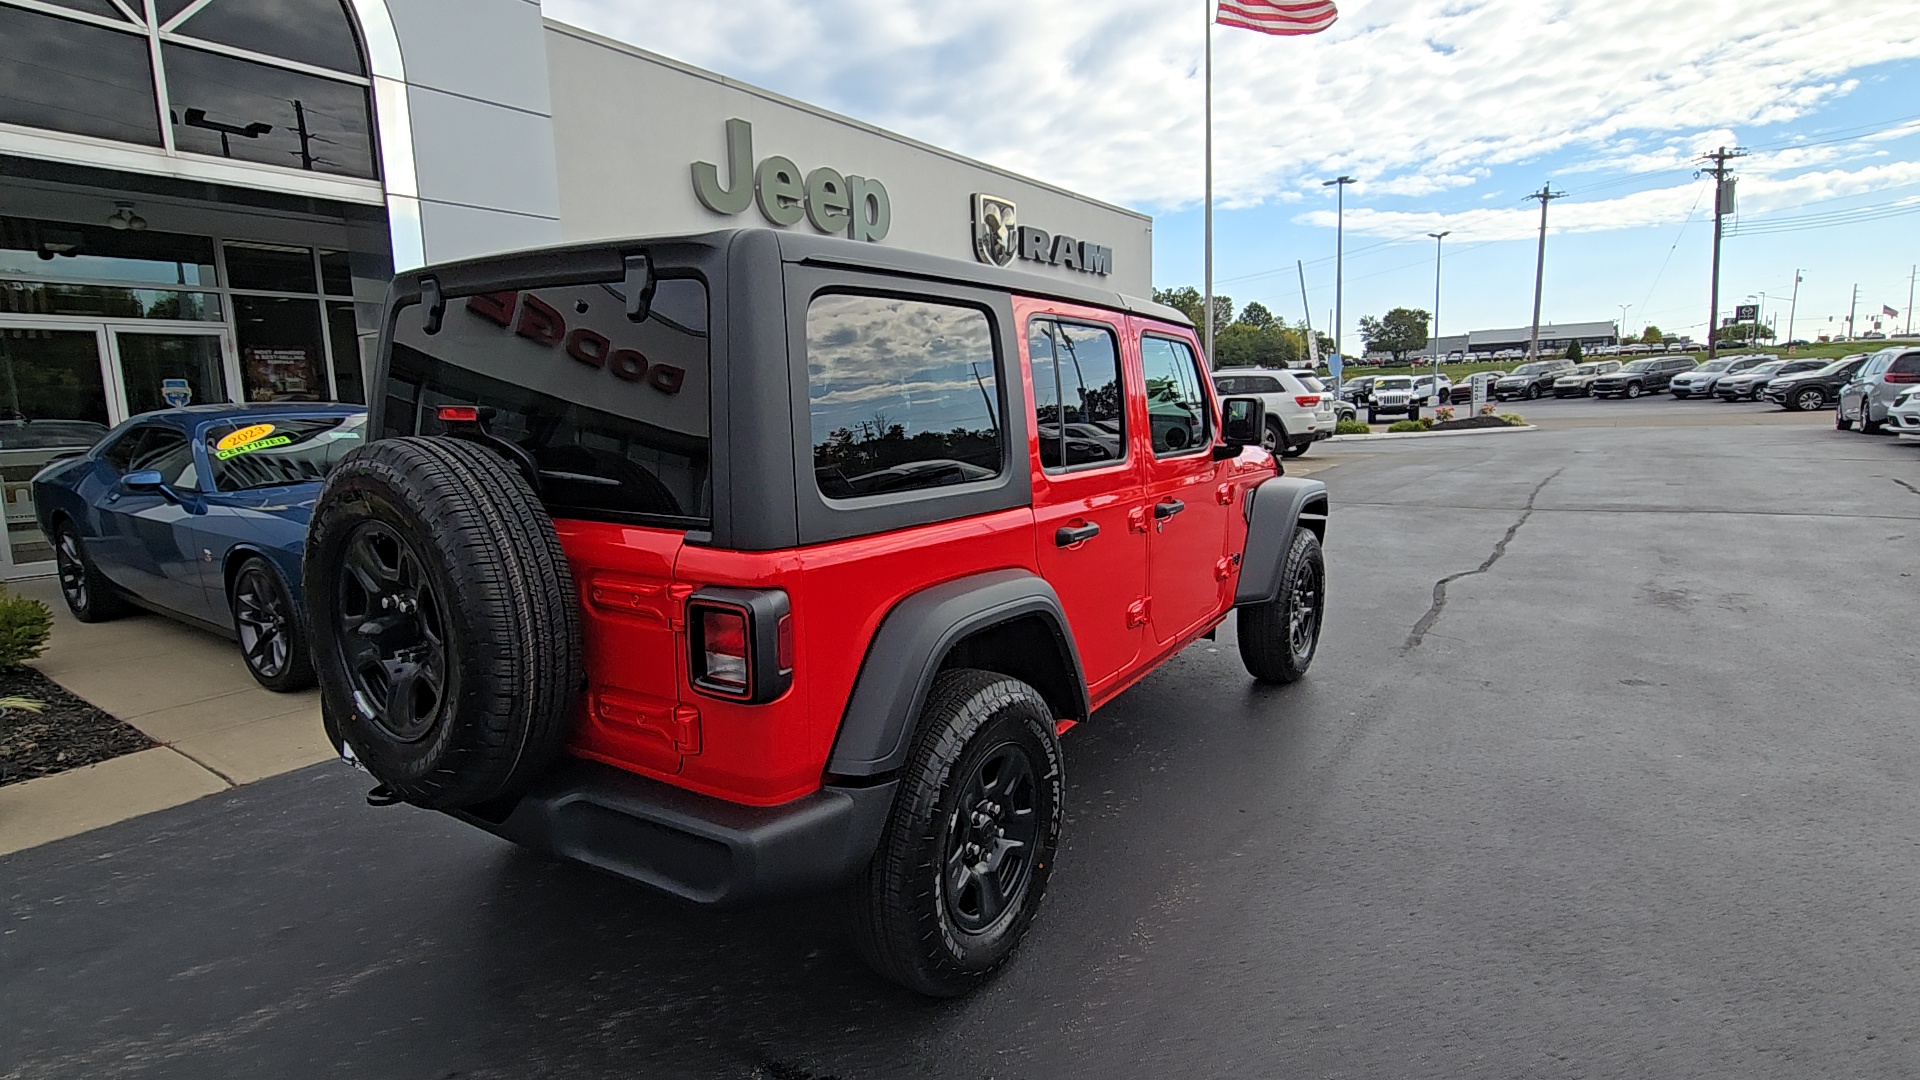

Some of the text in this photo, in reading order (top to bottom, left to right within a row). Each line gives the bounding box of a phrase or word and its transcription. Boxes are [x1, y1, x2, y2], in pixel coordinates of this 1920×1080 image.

[690, 117, 891, 242] Jeep
[1018, 224, 1113, 276] RAM
[219, 437, 287, 459] CERTIFIED
[228, 426, 266, 447] 2023
